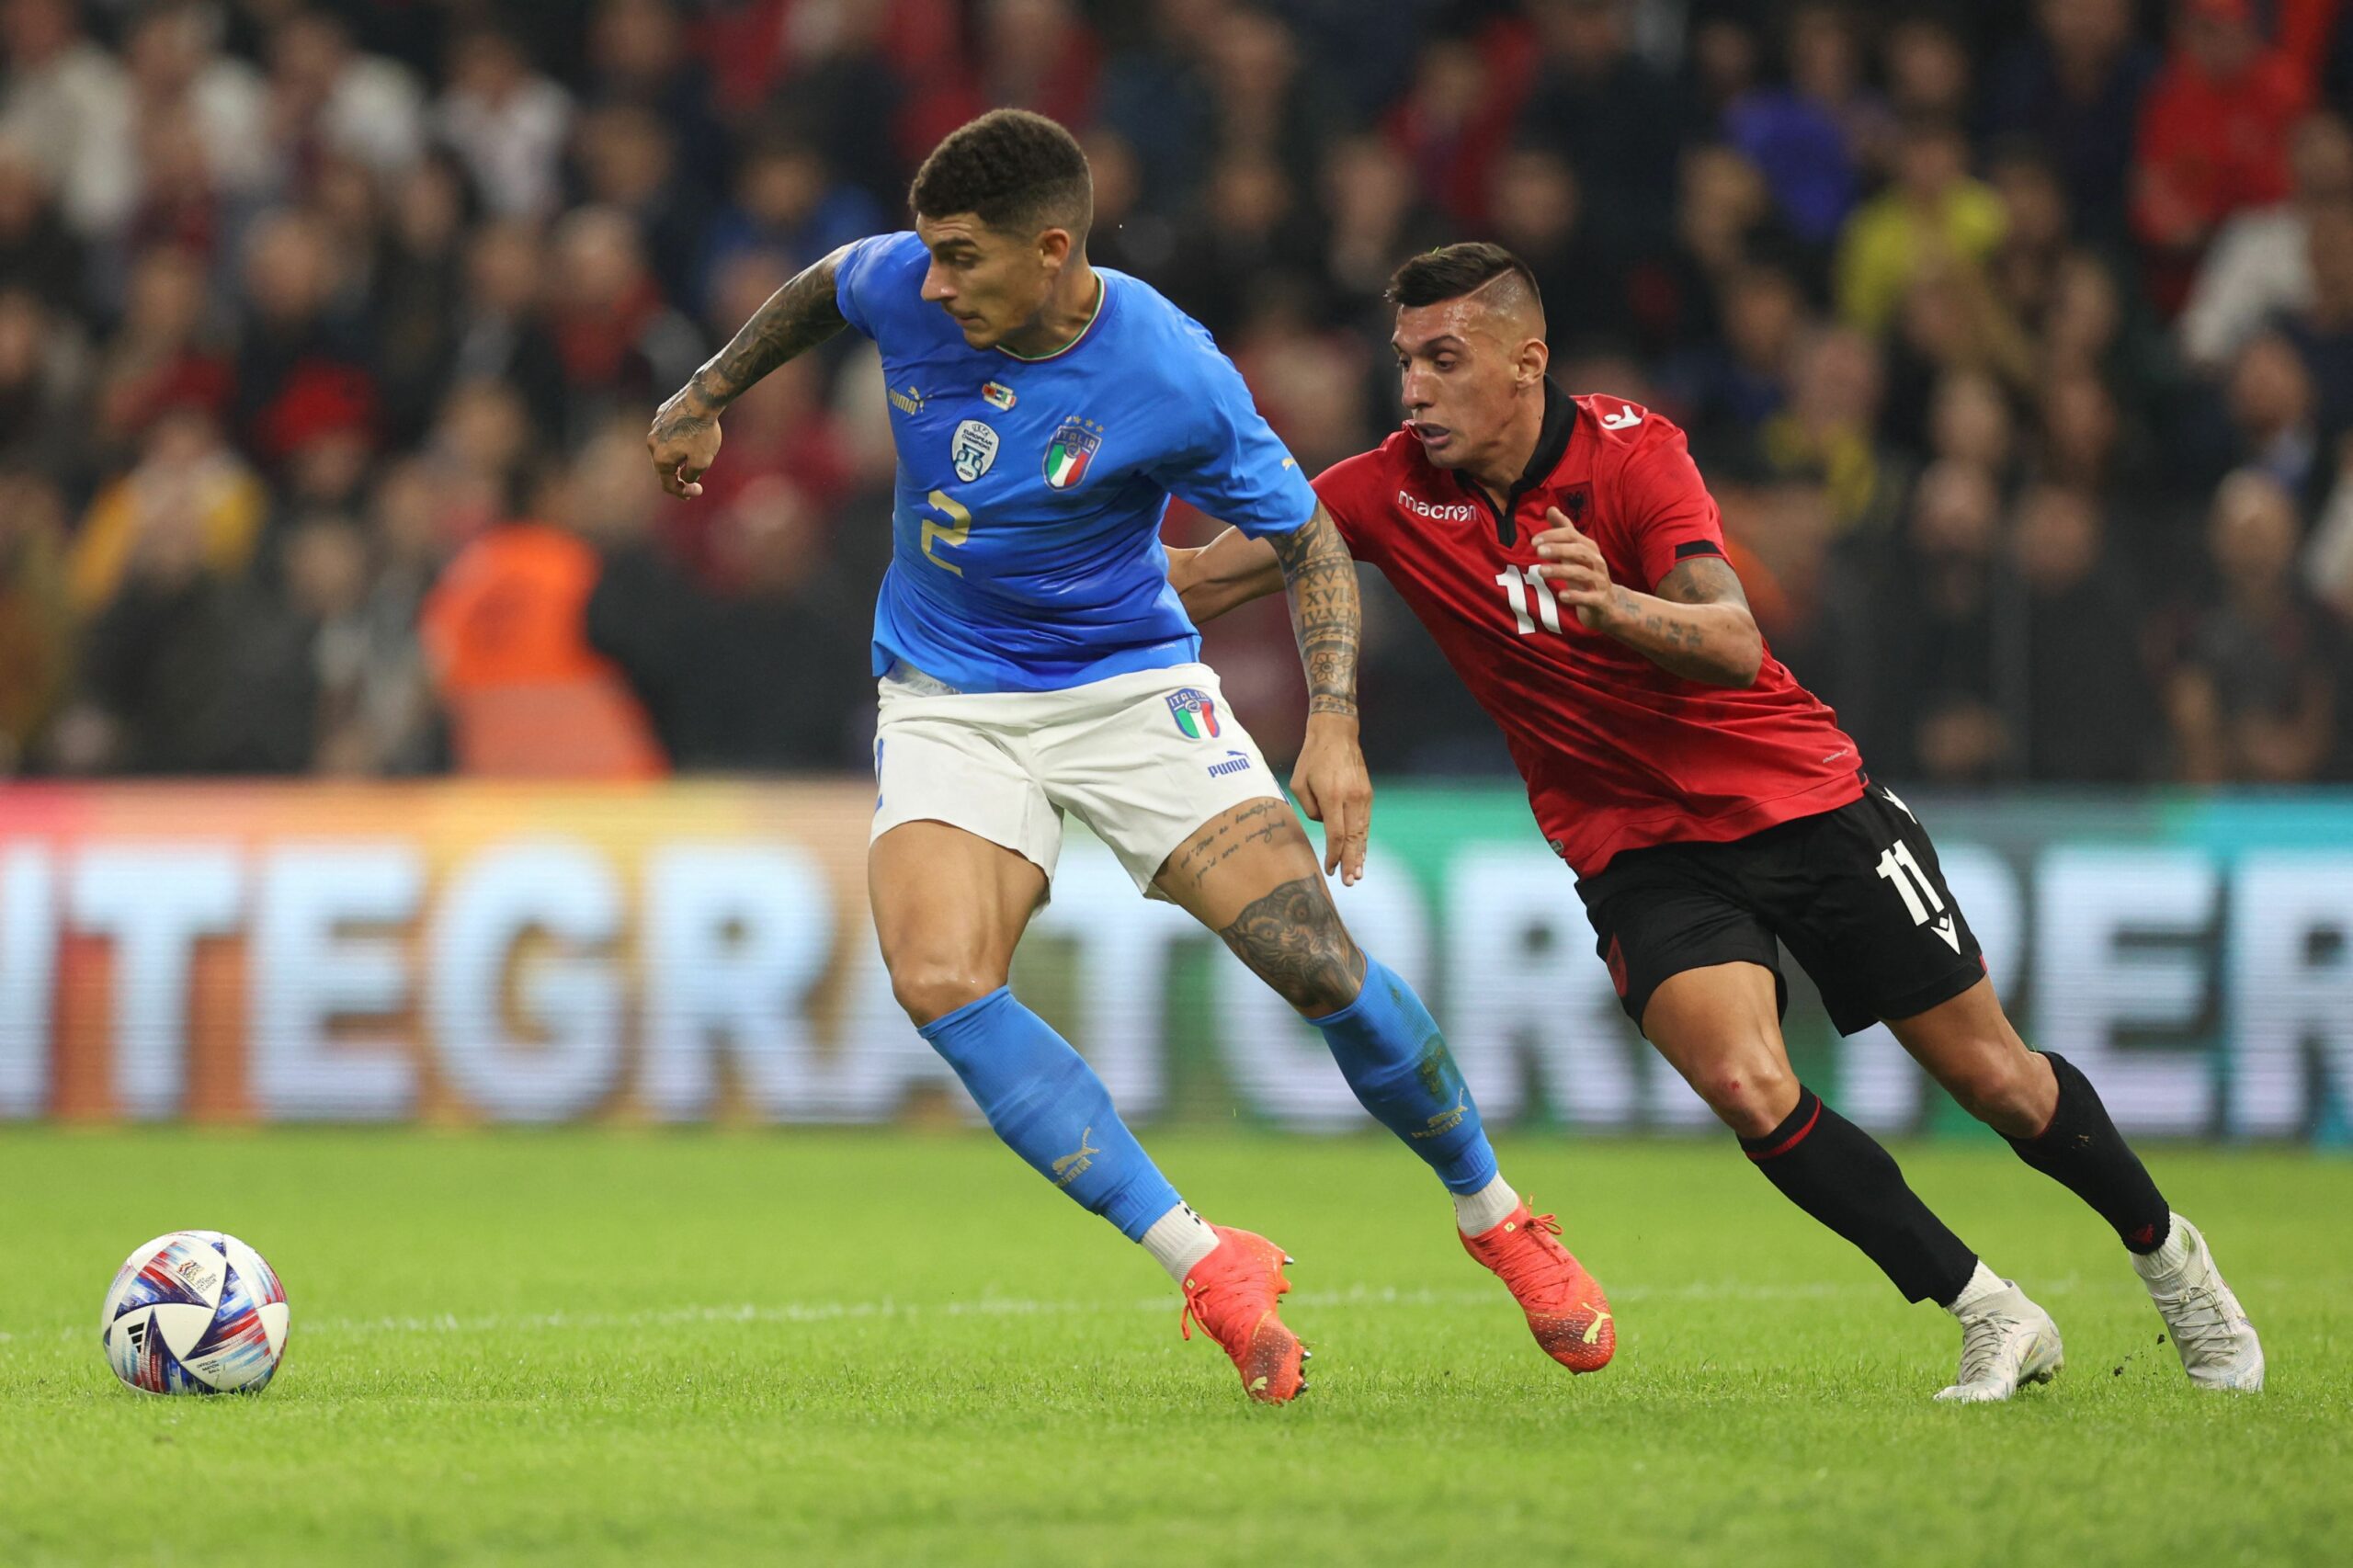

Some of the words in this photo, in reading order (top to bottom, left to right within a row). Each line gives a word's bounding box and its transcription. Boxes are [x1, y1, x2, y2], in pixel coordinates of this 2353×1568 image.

[963, 428, 993, 446] EUROPEAN
[1056, 429, 1096, 450] ITALIA
[1398, 490, 1477, 522] macron
[921, 490, 972, 578] 2
[1495, 563, 1563, 634] 11
[1169, 690, 1209, 707] ITALIA
[1207, 756, 1251, 778] PUMA
[1875, 838, 1945, 927] 11
[0, 835, 1728, 1129] TEGRTOR
